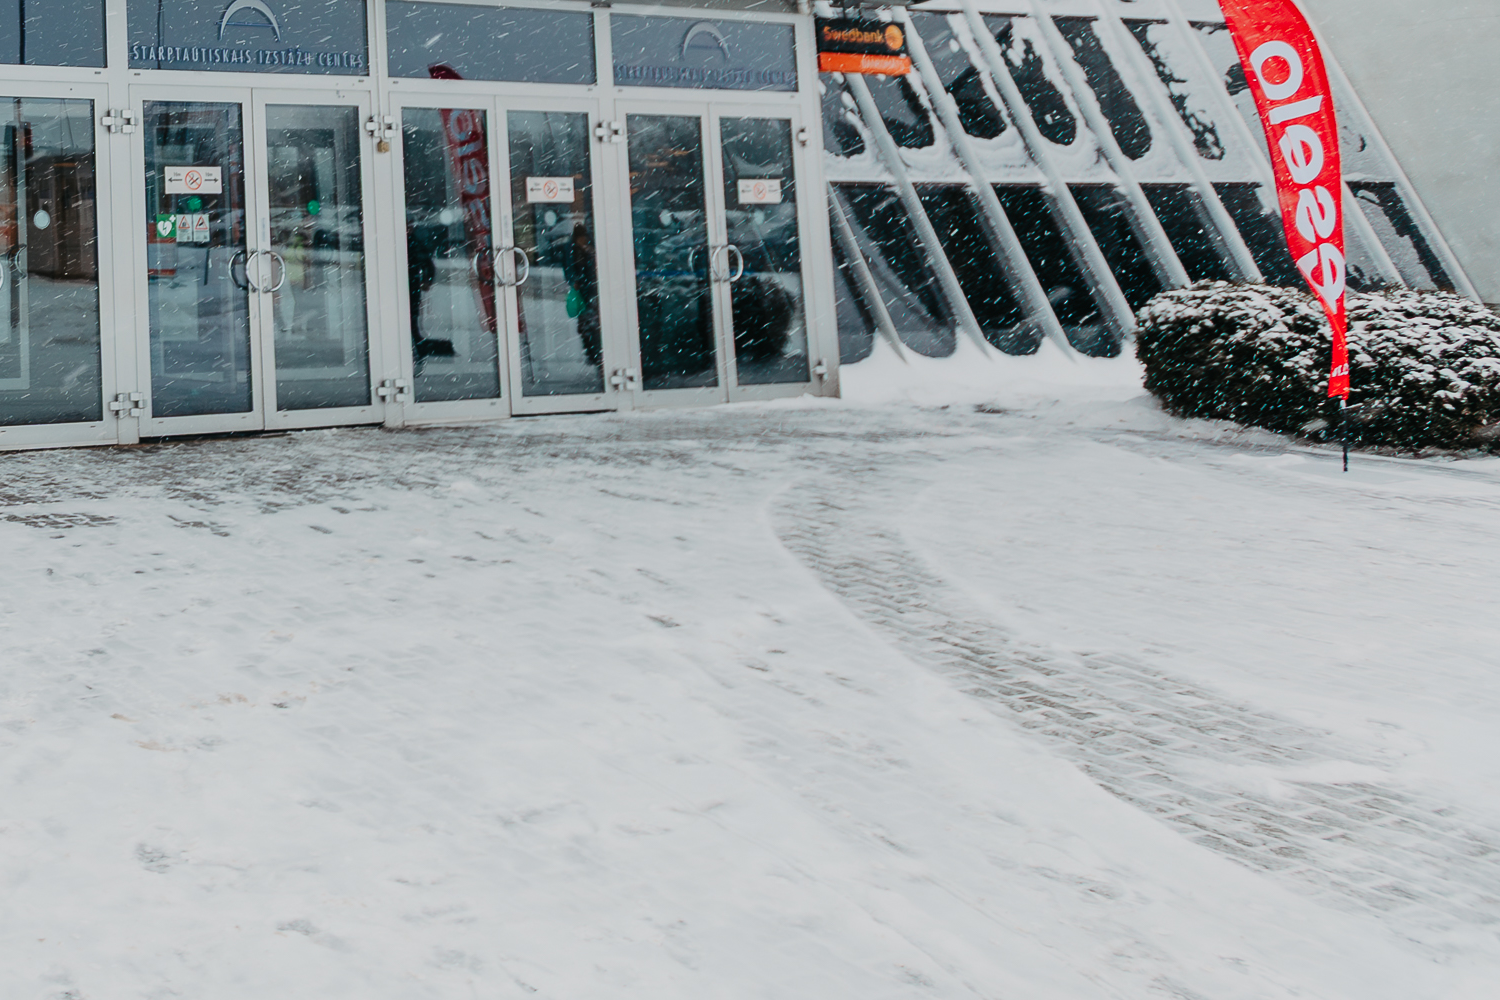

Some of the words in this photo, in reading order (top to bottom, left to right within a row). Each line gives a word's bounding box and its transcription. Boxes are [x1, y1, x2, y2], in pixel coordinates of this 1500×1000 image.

[823, 25, 886, 44] Swedbank
[133, 45, 251, 64] STARPTAUTISKAIS
[318, 51, 364, 68] CENTRS
